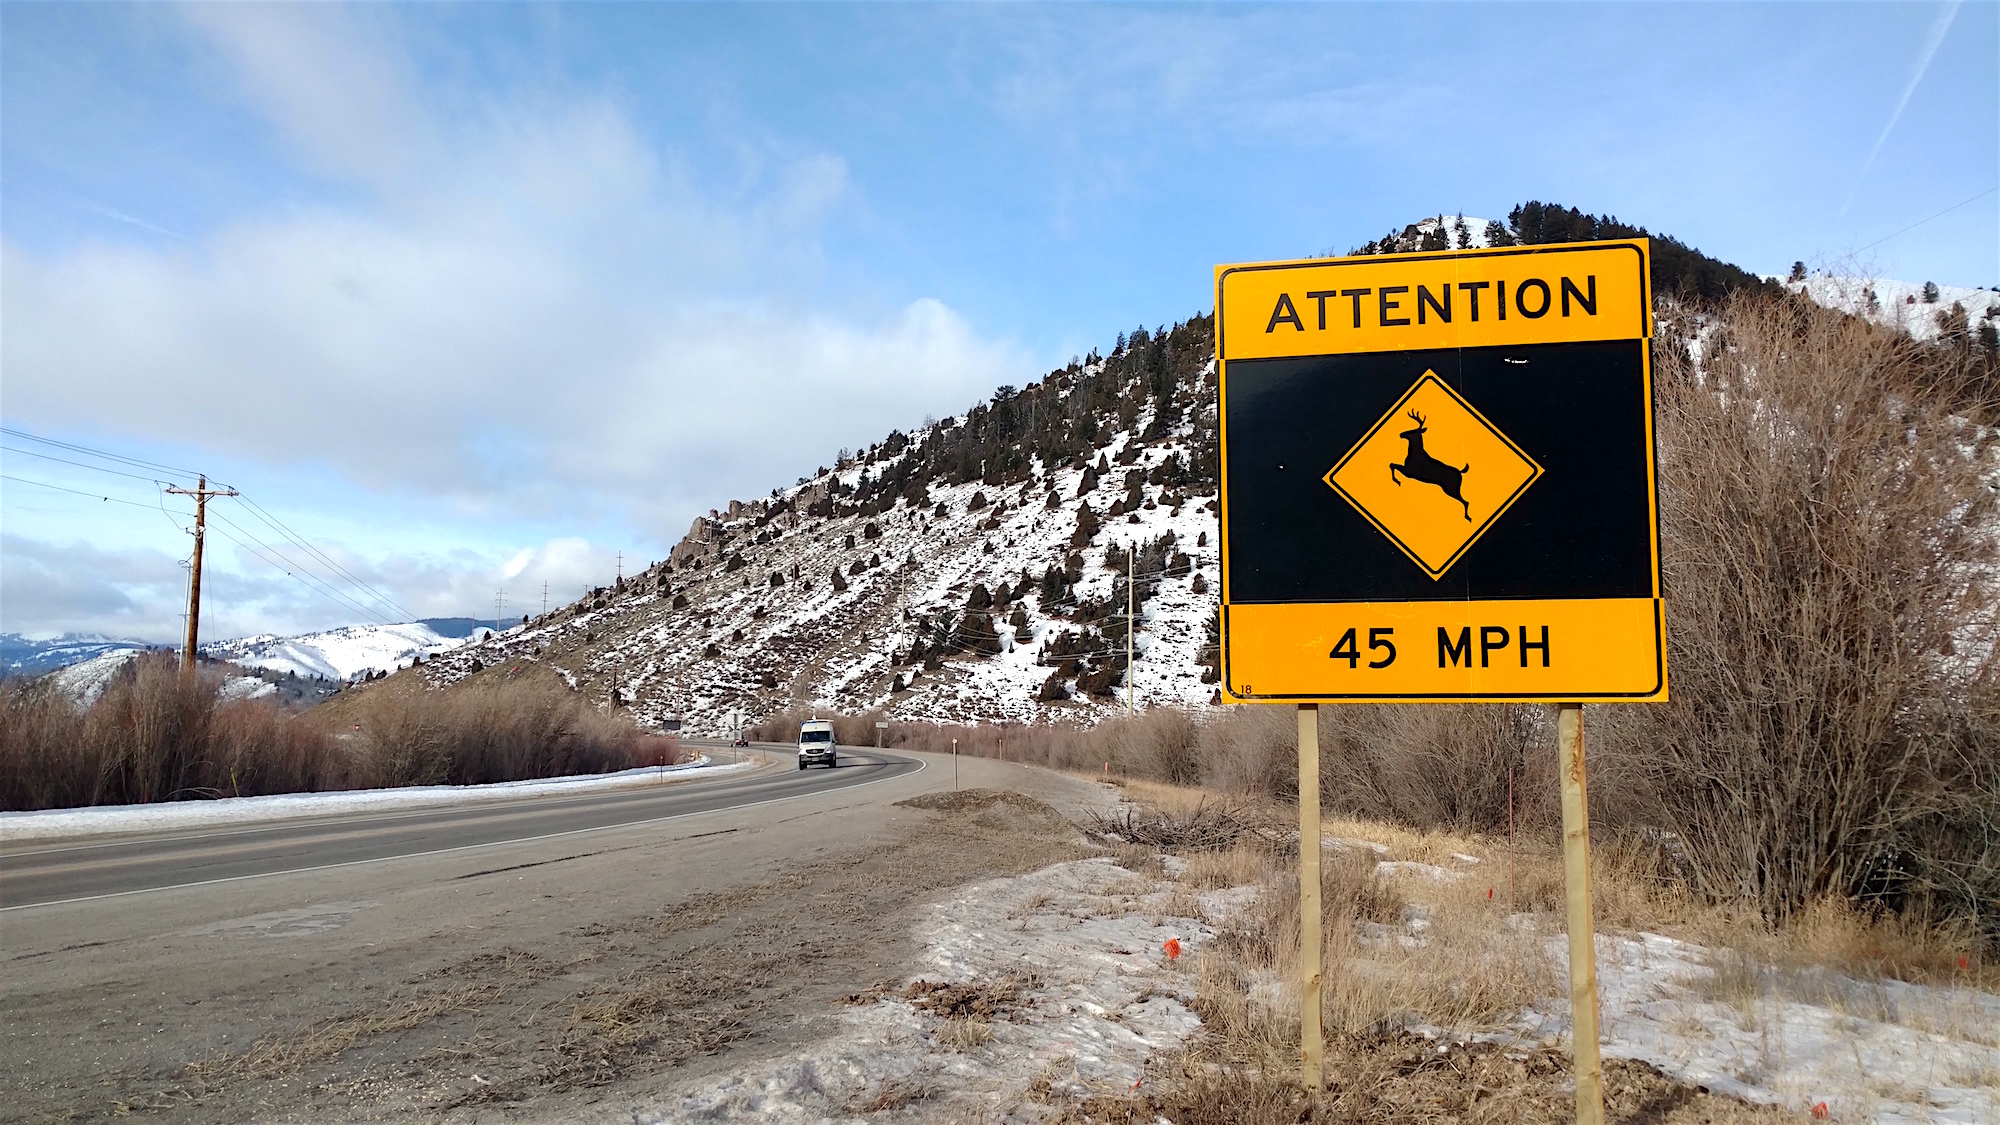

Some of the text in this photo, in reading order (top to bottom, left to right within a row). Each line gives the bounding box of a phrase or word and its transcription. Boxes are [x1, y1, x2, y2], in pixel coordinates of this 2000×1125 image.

[1265, 274, 1598, 334] ATTENTION
[1329, 625, 1550, 669] 45 MPH
[1240, 684, 1252, 695] 18
